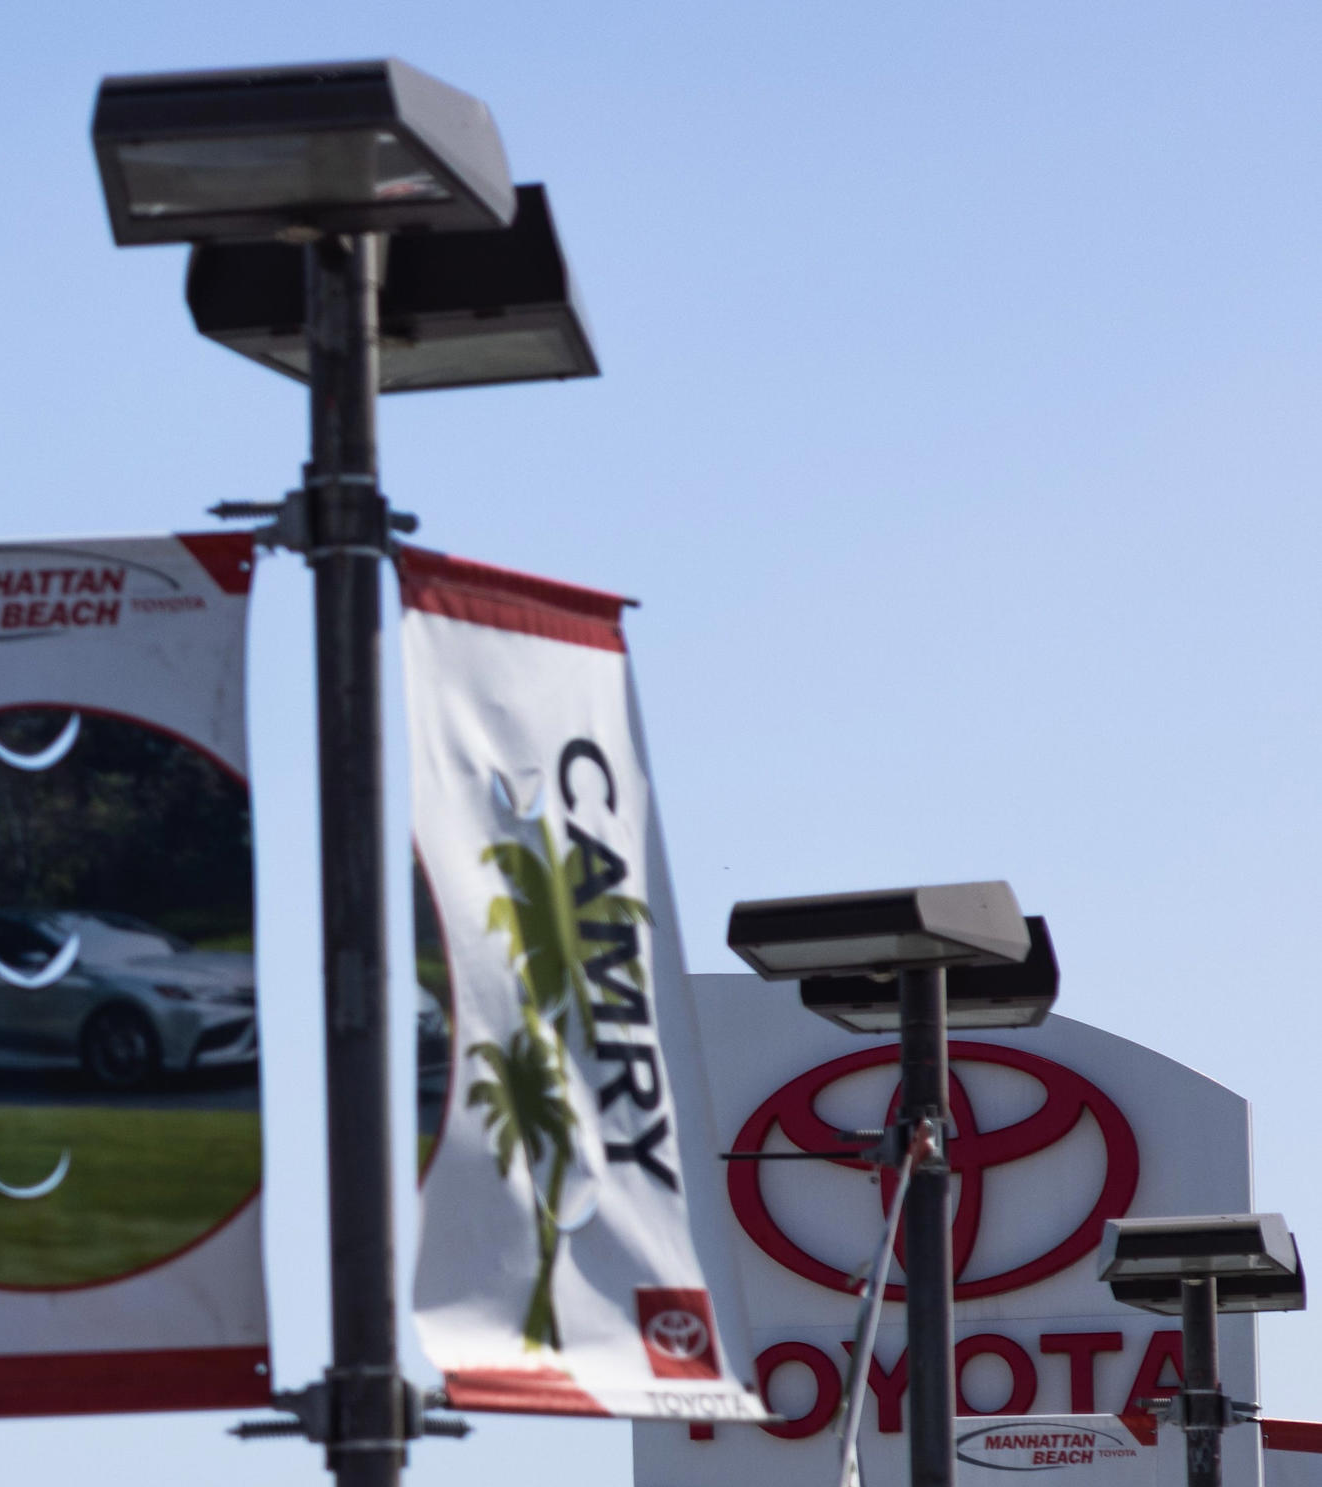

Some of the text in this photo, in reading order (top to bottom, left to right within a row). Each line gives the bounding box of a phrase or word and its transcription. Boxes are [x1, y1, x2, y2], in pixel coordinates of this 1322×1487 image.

[0, 600, 120, 630] BEACH
[558, 737, 681, 1194] CAMRY
[687, 1330, 1191, 1441] OYOTA
[646, 1391, 751, 1418] TOYOTA
[985, 1433, 1096, 1450] MANHATTAN
[1032, 1449, 1137, 1465] BEACH TOYOTA
